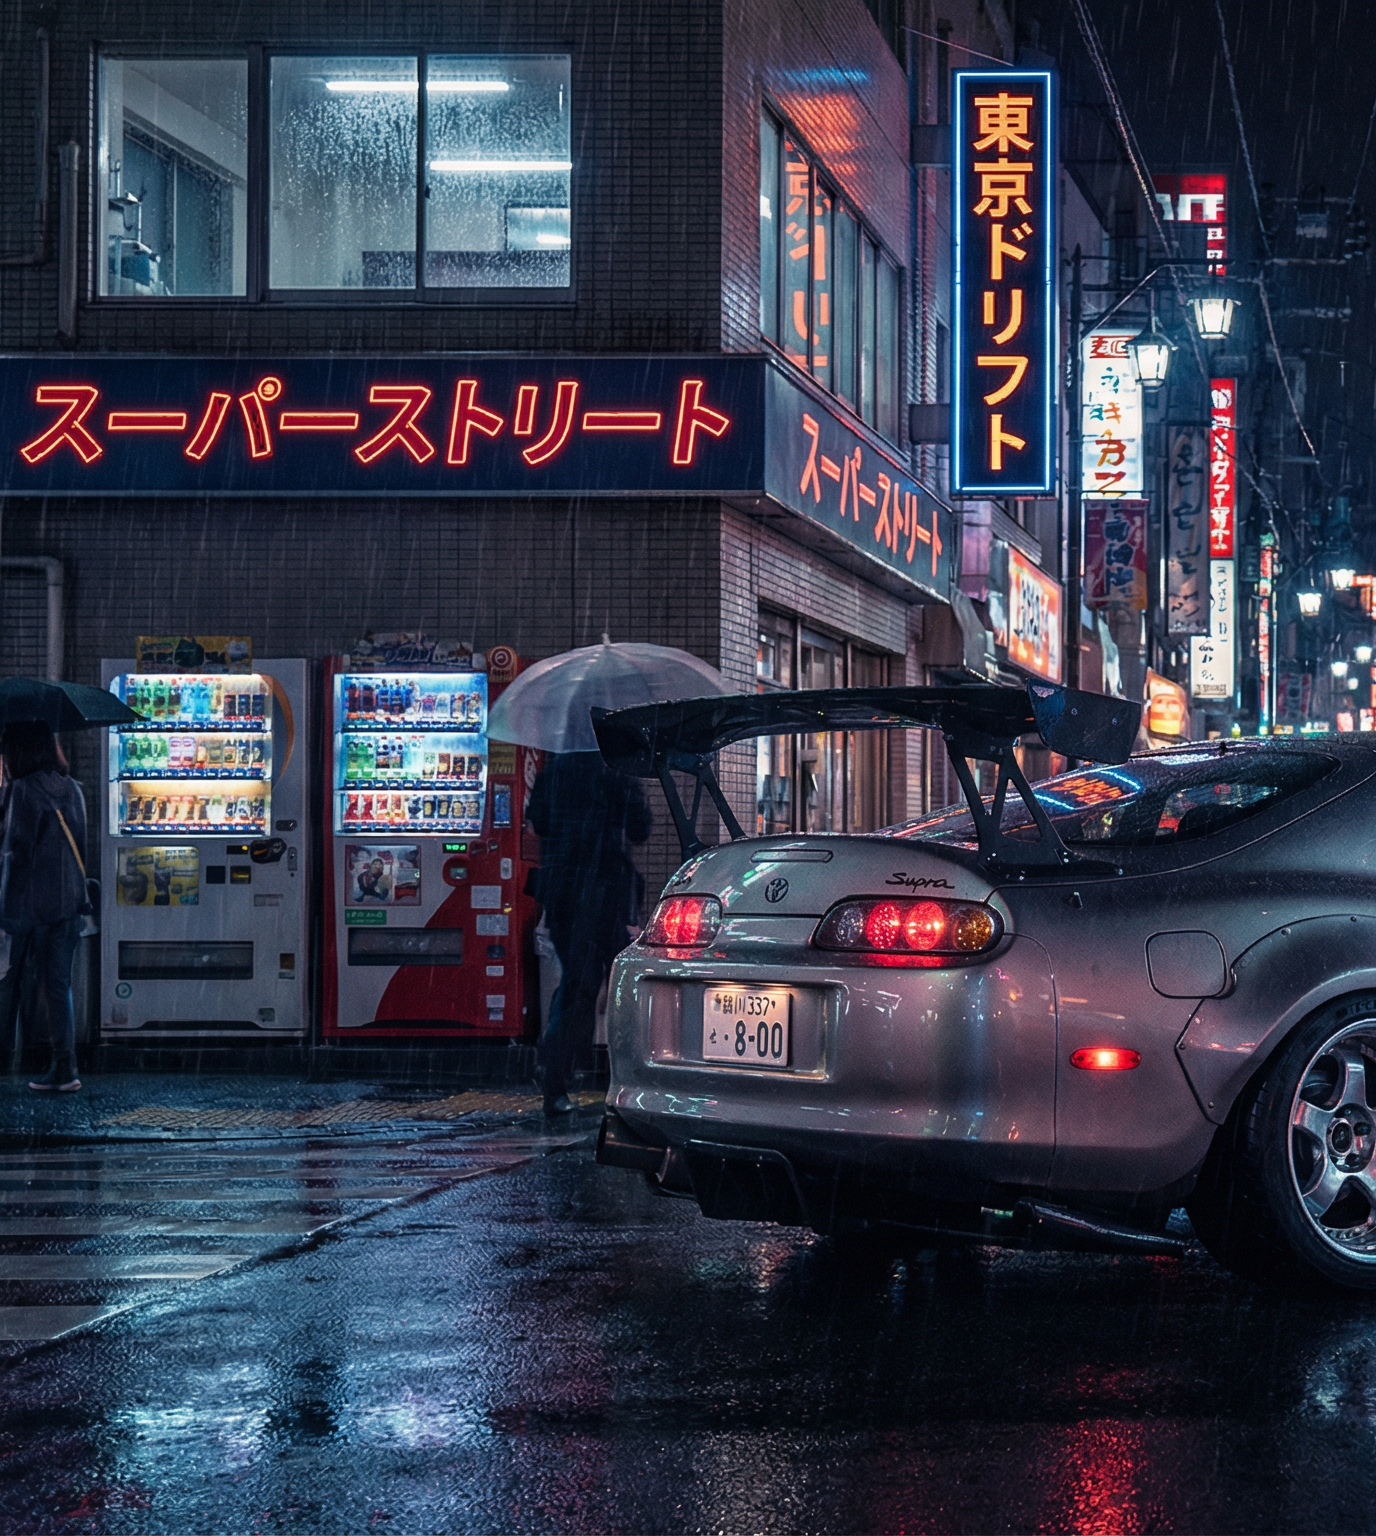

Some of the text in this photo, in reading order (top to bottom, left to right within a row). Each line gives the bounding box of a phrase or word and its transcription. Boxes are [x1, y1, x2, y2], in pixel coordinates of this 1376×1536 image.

[973, 92, 1034, 470] 東京ドリフト
[20, 376, 730, 465] スーパーストリート
[800, 413, 942, 577] スーパーストリート
[885, 872, 955, 893] Supra
